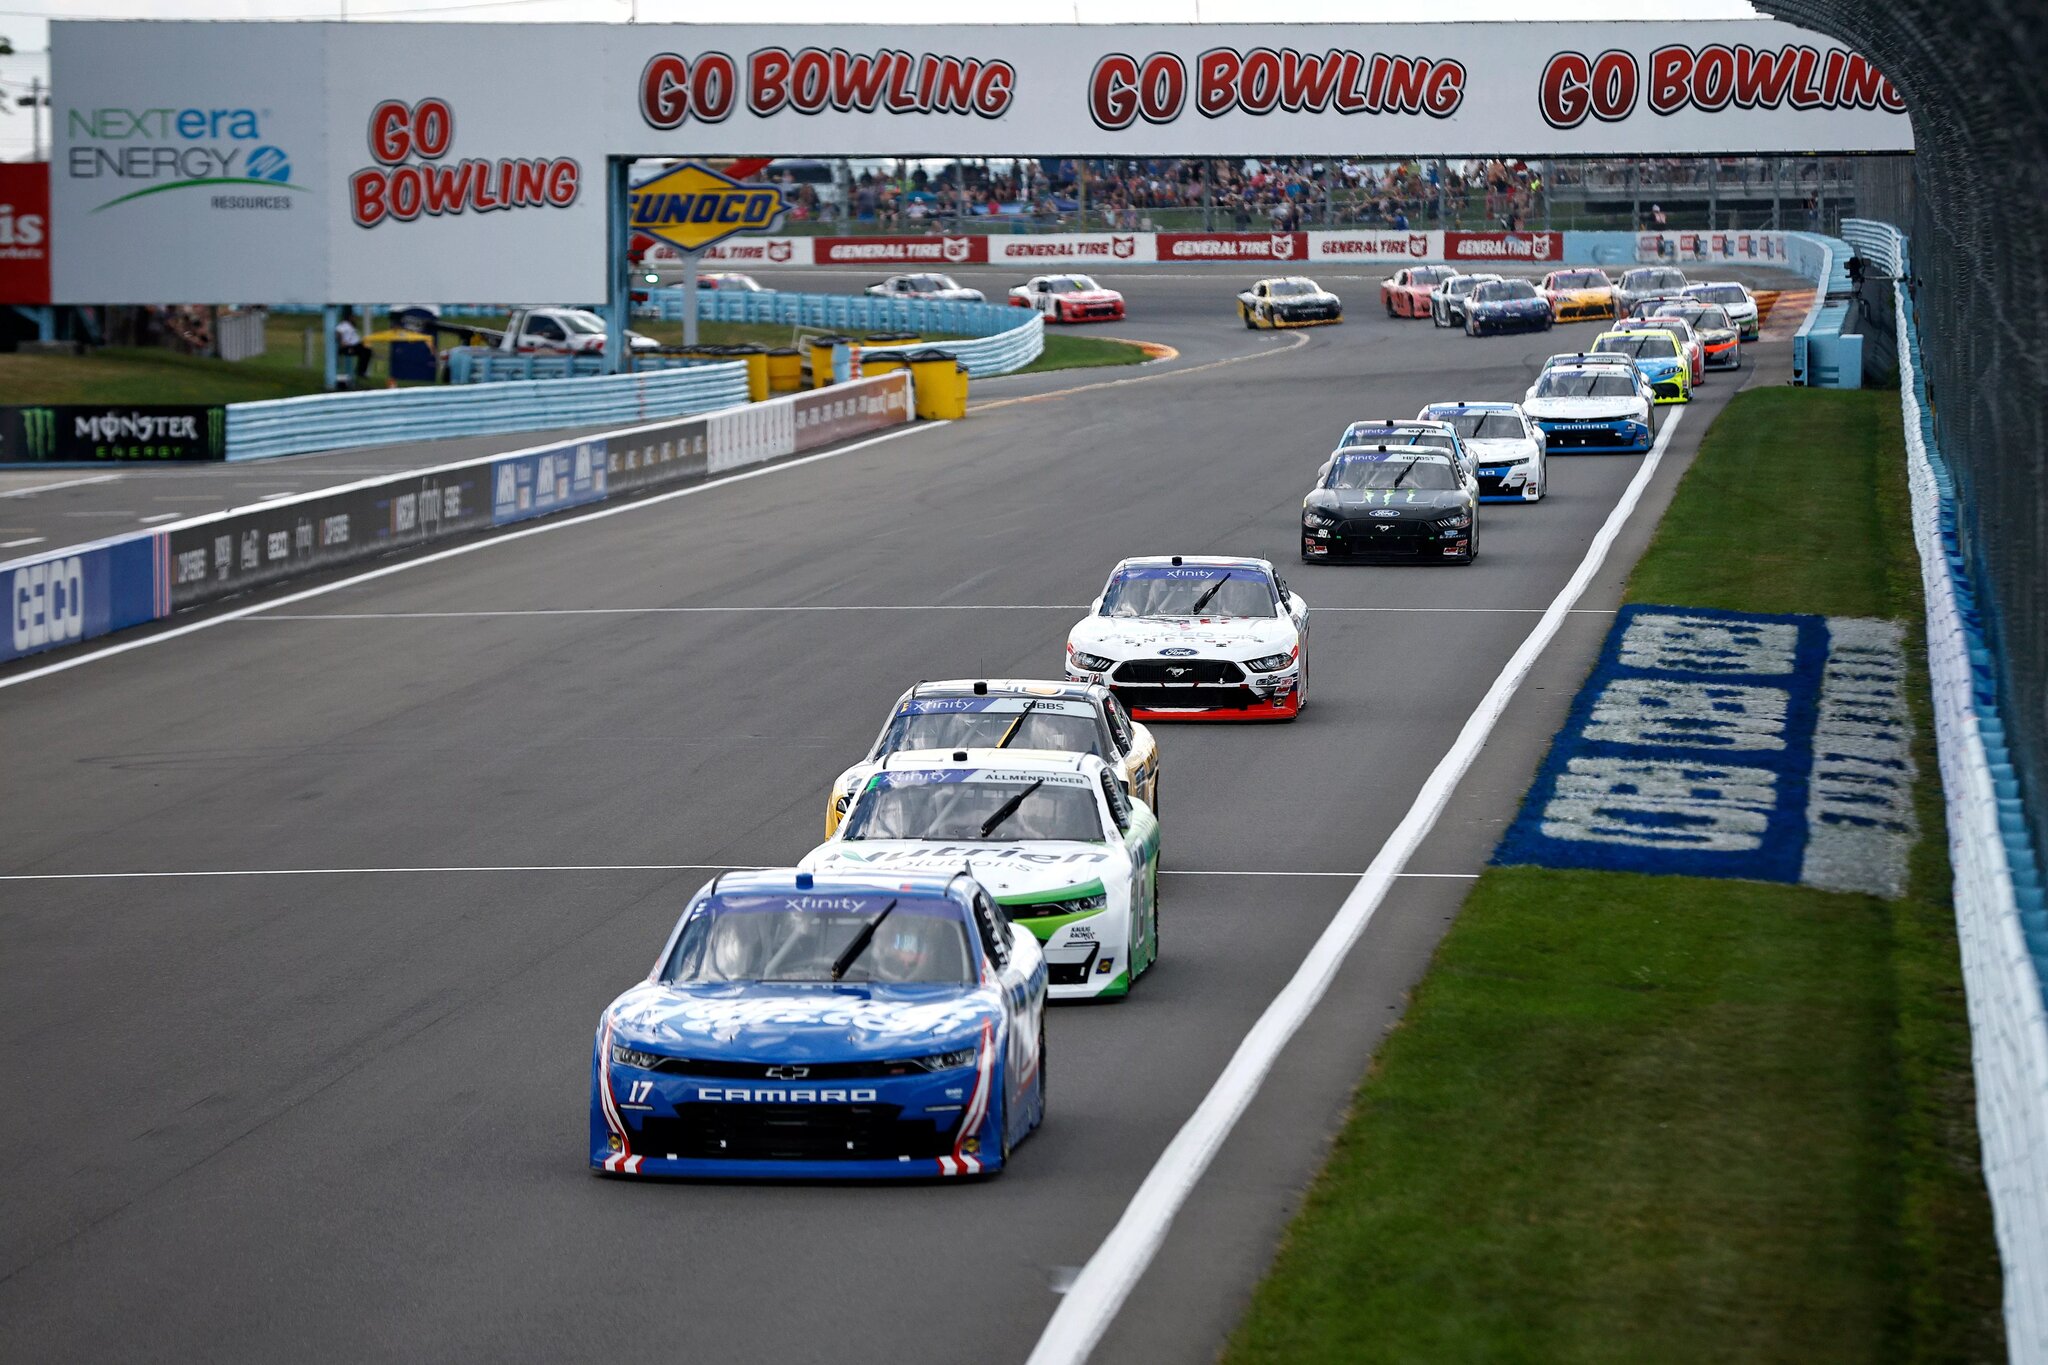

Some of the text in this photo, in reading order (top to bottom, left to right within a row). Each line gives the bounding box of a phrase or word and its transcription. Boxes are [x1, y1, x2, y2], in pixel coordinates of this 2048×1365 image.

[639, 46, 1015, 130] GO BOWLING
[1087, 46, 1467, 130] GO BOWLING
[1538, 49, 1639, 129] GO
[68, 108, 261, 140] NEXTera
[367, 97, 454, 166] GO
[69, 147, 240, 179] ENERGY
[349, 156, 583, 229] BOWLING
[211, 196, 292, 209] RESOURCES
[655, 246, 764, 259] GEAL TIRE
[829, 243, 943, 259] GENERAL TIRE
[1005, 242, 1110, 257] GENERAL TIRE
[1172, 240, 1271, 256] GENERAL TIRE
[1322, 239, 1407, 253] GENERAL TIRE
[1457, 240, 1532, 256] GENERAL TIRE
[74, 411, 198, 442] MONSTER
[95, 446, 183, 458] ENERGY
[1318, 528, 1328, 538] 98
[1166, 569, 1214, 579] xfinity
[13, 555, 83, 651] GEICO
[912, 699, 975, 712] xfinity
[985, 774, 1084, 785] ALLMENDINGER
[1540, 756, 1779, 851] GEICO
[785, 896, 867, 914] xfinity
[628, 1080, 654, 1103] 17
[698, 1087, 877, 1102] CAMARO
